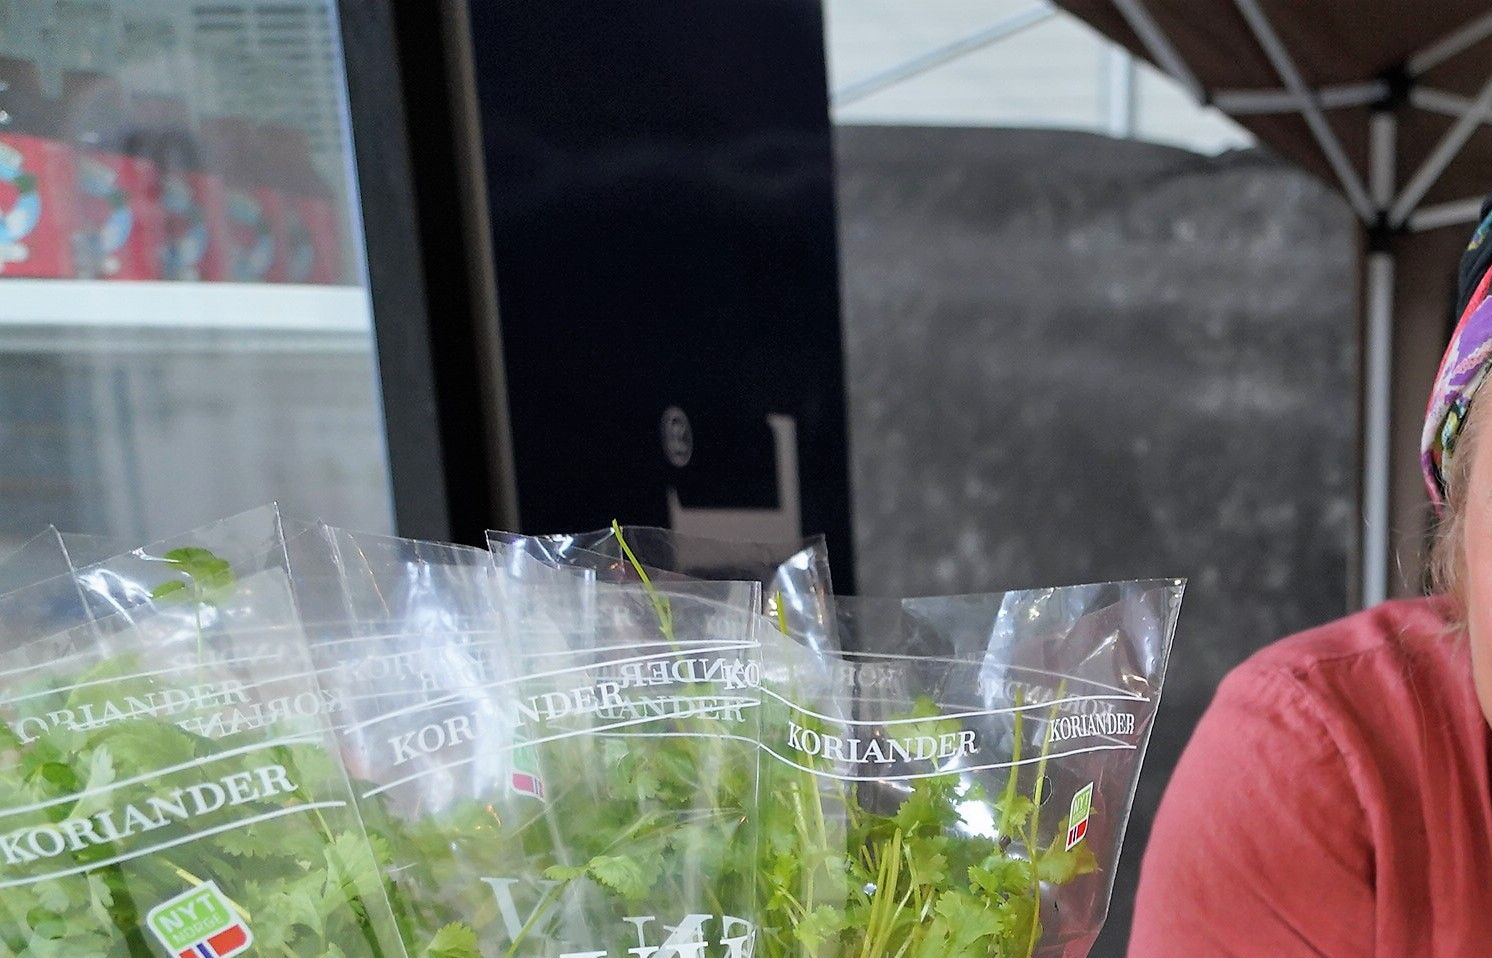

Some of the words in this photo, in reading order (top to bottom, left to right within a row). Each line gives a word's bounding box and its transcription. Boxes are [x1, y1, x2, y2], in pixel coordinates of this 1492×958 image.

[788, 721, 977, 764] KORIANDER
[1049, 713, 1135, 743] KORIANDER
[2, 763, 298, 865] KORIANDER
[158, 892, 217, 933] NYT
